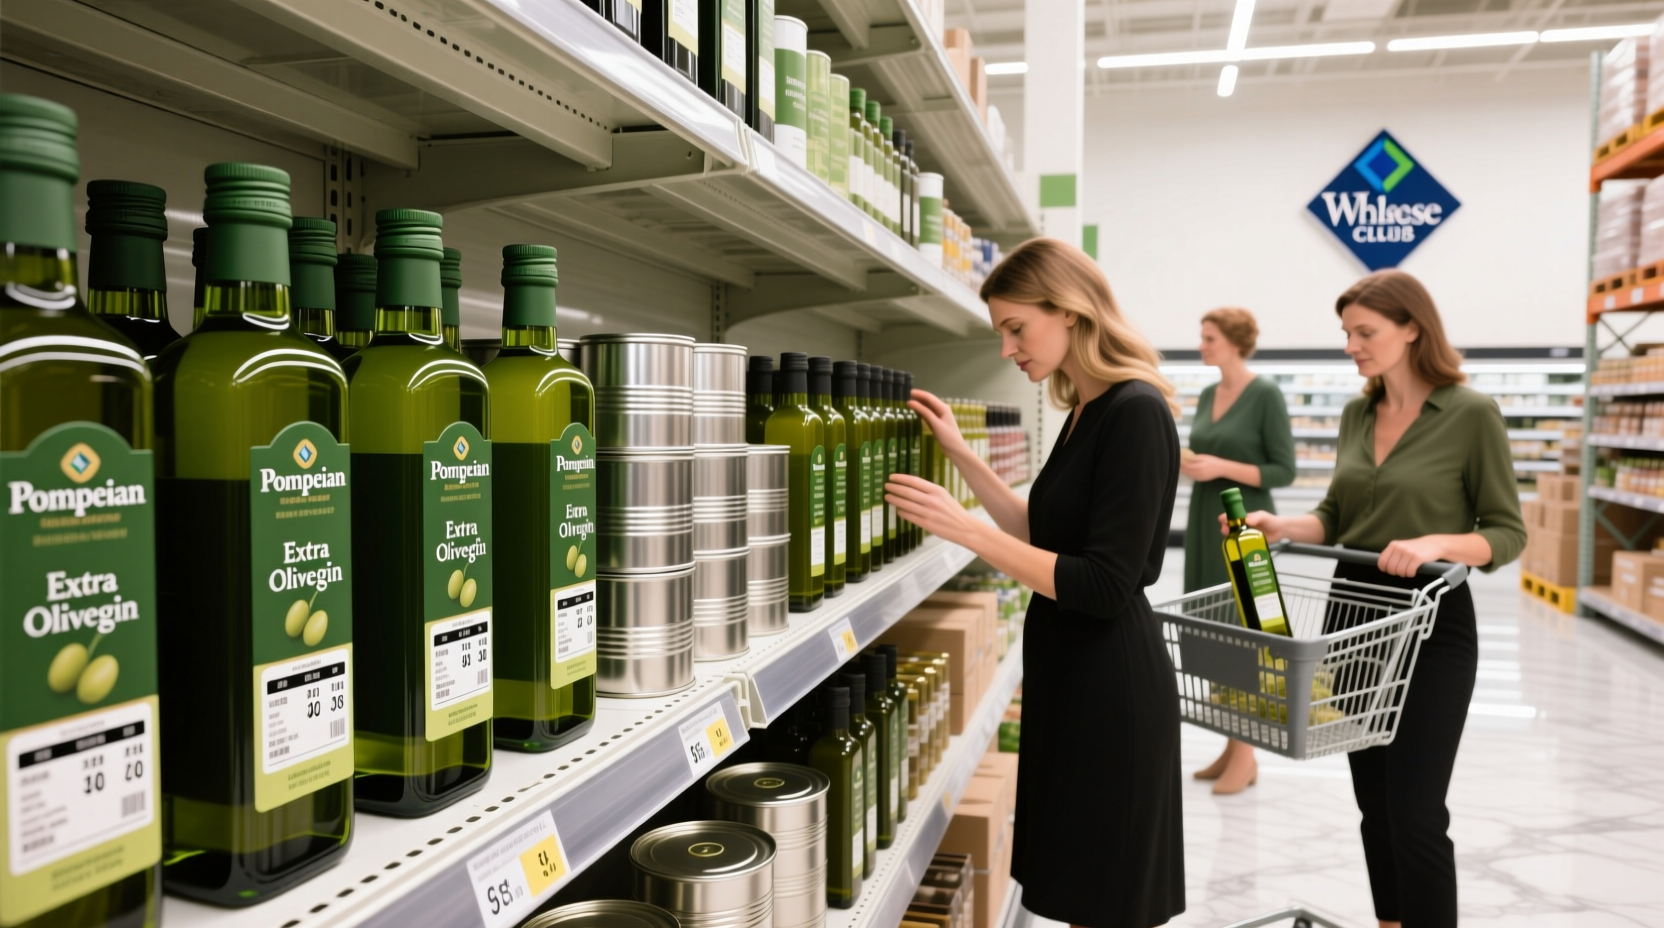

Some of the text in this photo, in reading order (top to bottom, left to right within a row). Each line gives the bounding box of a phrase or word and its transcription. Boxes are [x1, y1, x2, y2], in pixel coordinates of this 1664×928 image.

[259, 466, 346, 496] Pompeian
[7, 478, 147, 517] Pompeian
[446, 520, 478, 539] Extra
[283, 541, 330, 564] Extra
[46, 570, 119, 602] Extra
[268, 561, 343, 592] Olivegin
[23, 594, 140, 638] Olivegin
